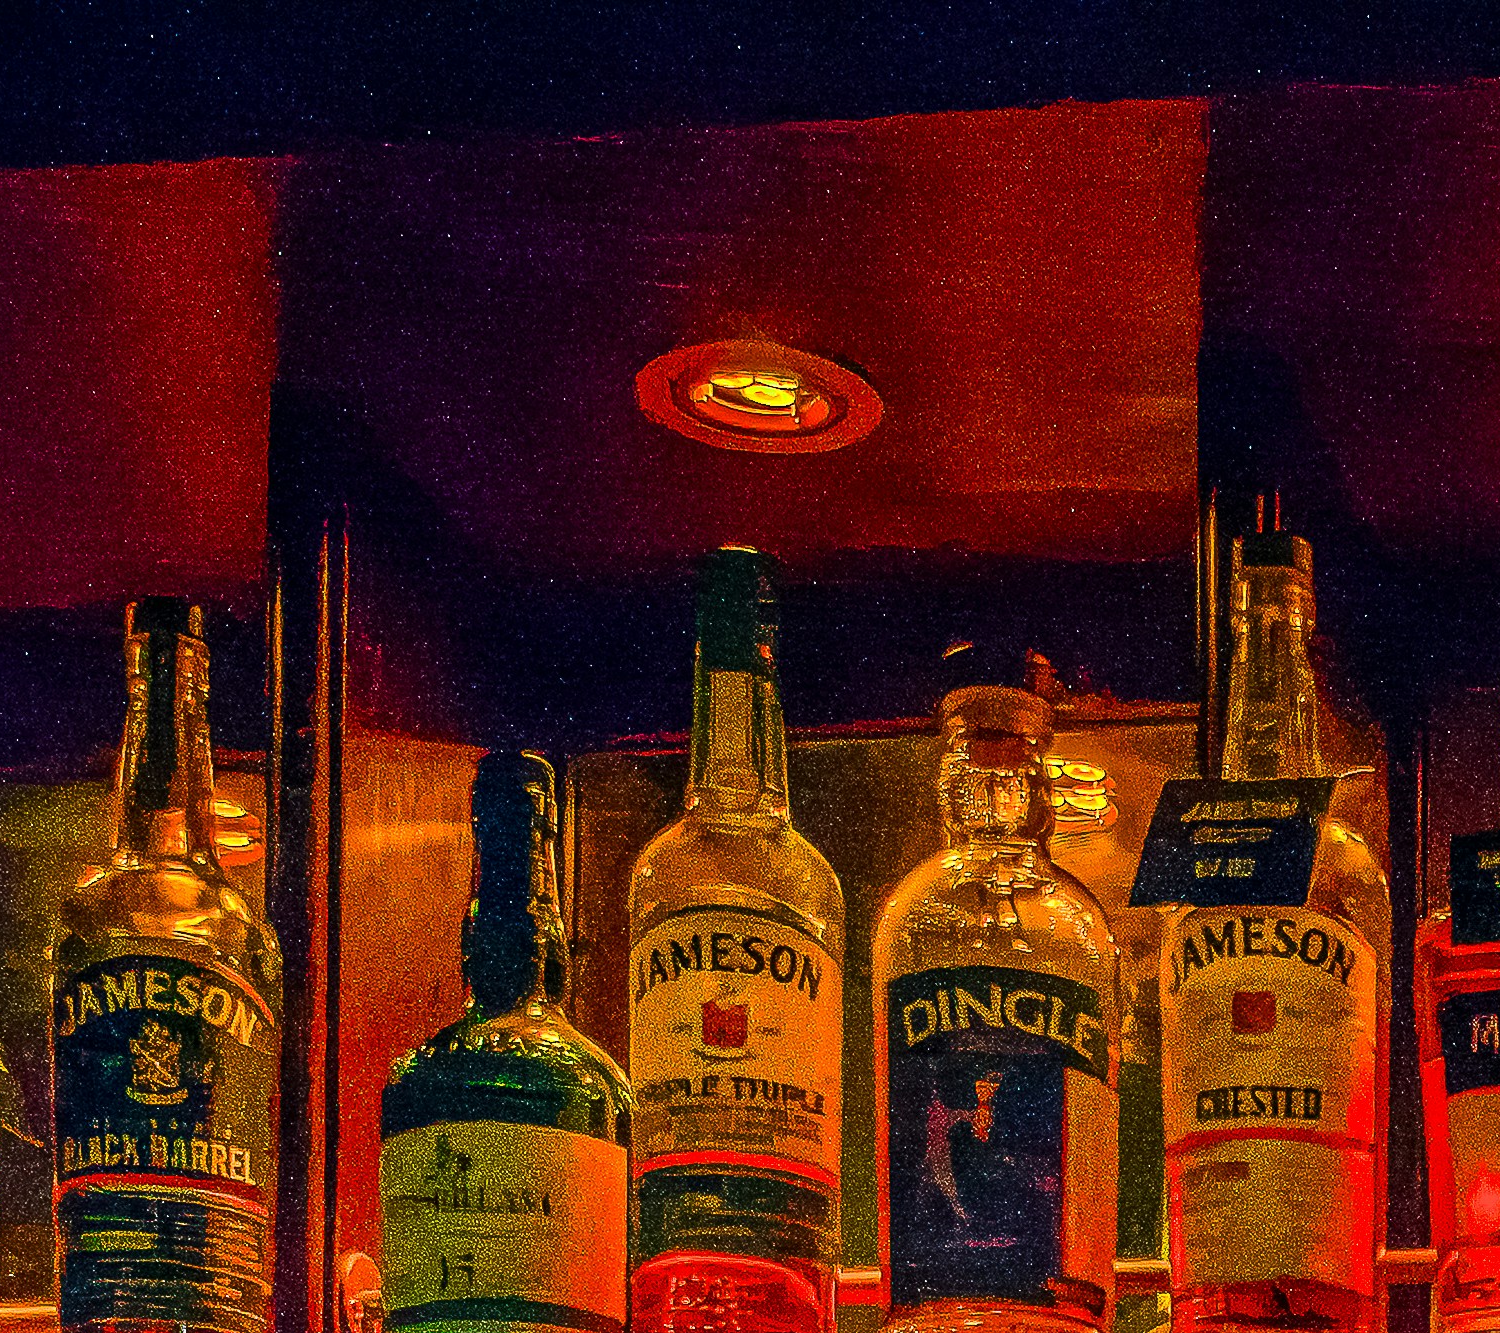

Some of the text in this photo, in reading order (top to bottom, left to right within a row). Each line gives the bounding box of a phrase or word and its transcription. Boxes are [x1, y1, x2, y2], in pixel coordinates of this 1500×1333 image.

[636, 931, 821, 1001] JAMESON
[1171, 916, 1355, 988] JAMESON
[60, 969, 259, 1045] JAMESON
[903, 987, 1104, 1058] DINGLE
[1197, 1086, 1324, 1124] CRESTED
[149, 1134, 253, 1185] BARREL
